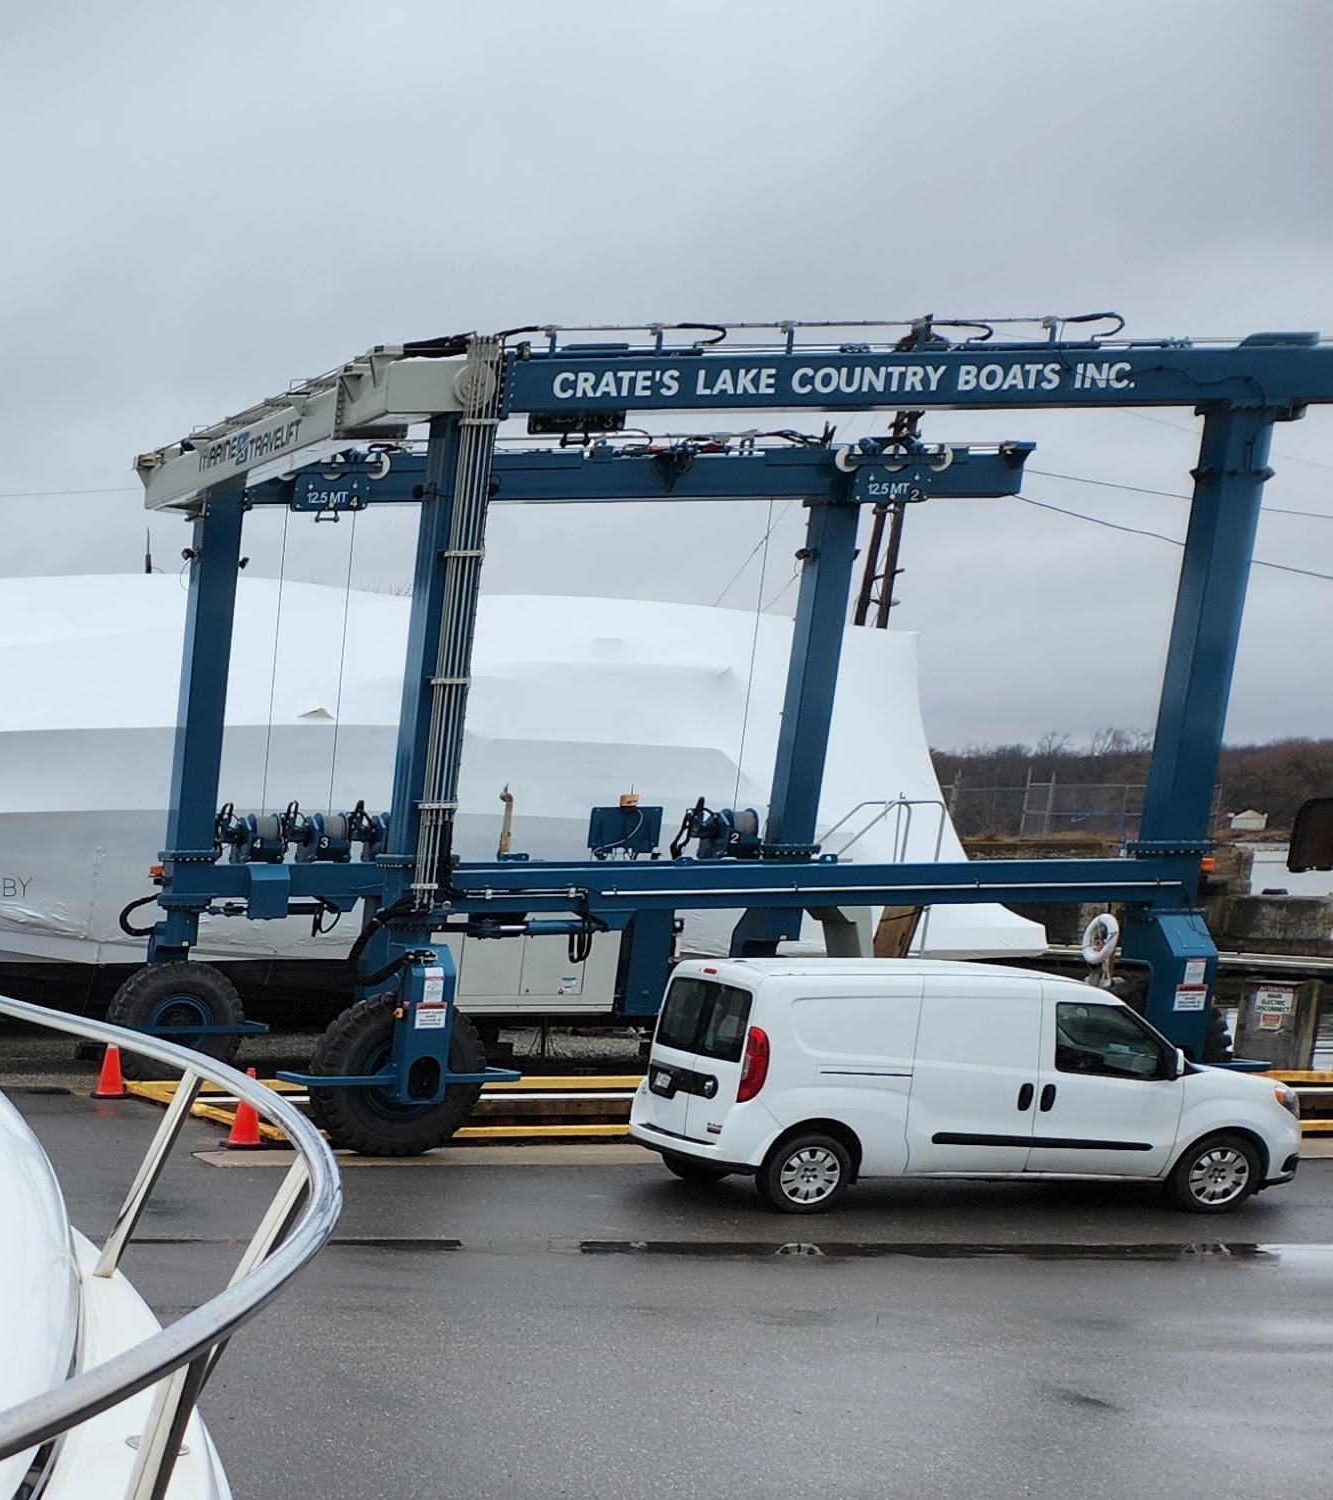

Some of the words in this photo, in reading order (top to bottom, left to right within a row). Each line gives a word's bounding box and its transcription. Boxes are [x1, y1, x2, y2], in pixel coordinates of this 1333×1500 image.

[552, 368, 680, 399] CRATE'S
[695, 367, 777, 396] LAKE
[791, 365, 947, 394] COUNTRY
[956, 362, 1061, 392] BOATS
[1073, 361, 1136, 390] INC.
[249, 418, 302, 461] TRAVELIFT
[890, 482, 910, 494] MT
[329, 491, 350, 504] MT
[910, 489, 920, 500] 2
[348, 495, 359, 508] 4
[253, 838, 262, 849] 4
[319, 837, 329, 848] 3
[729, 832, 740, 844] 2
